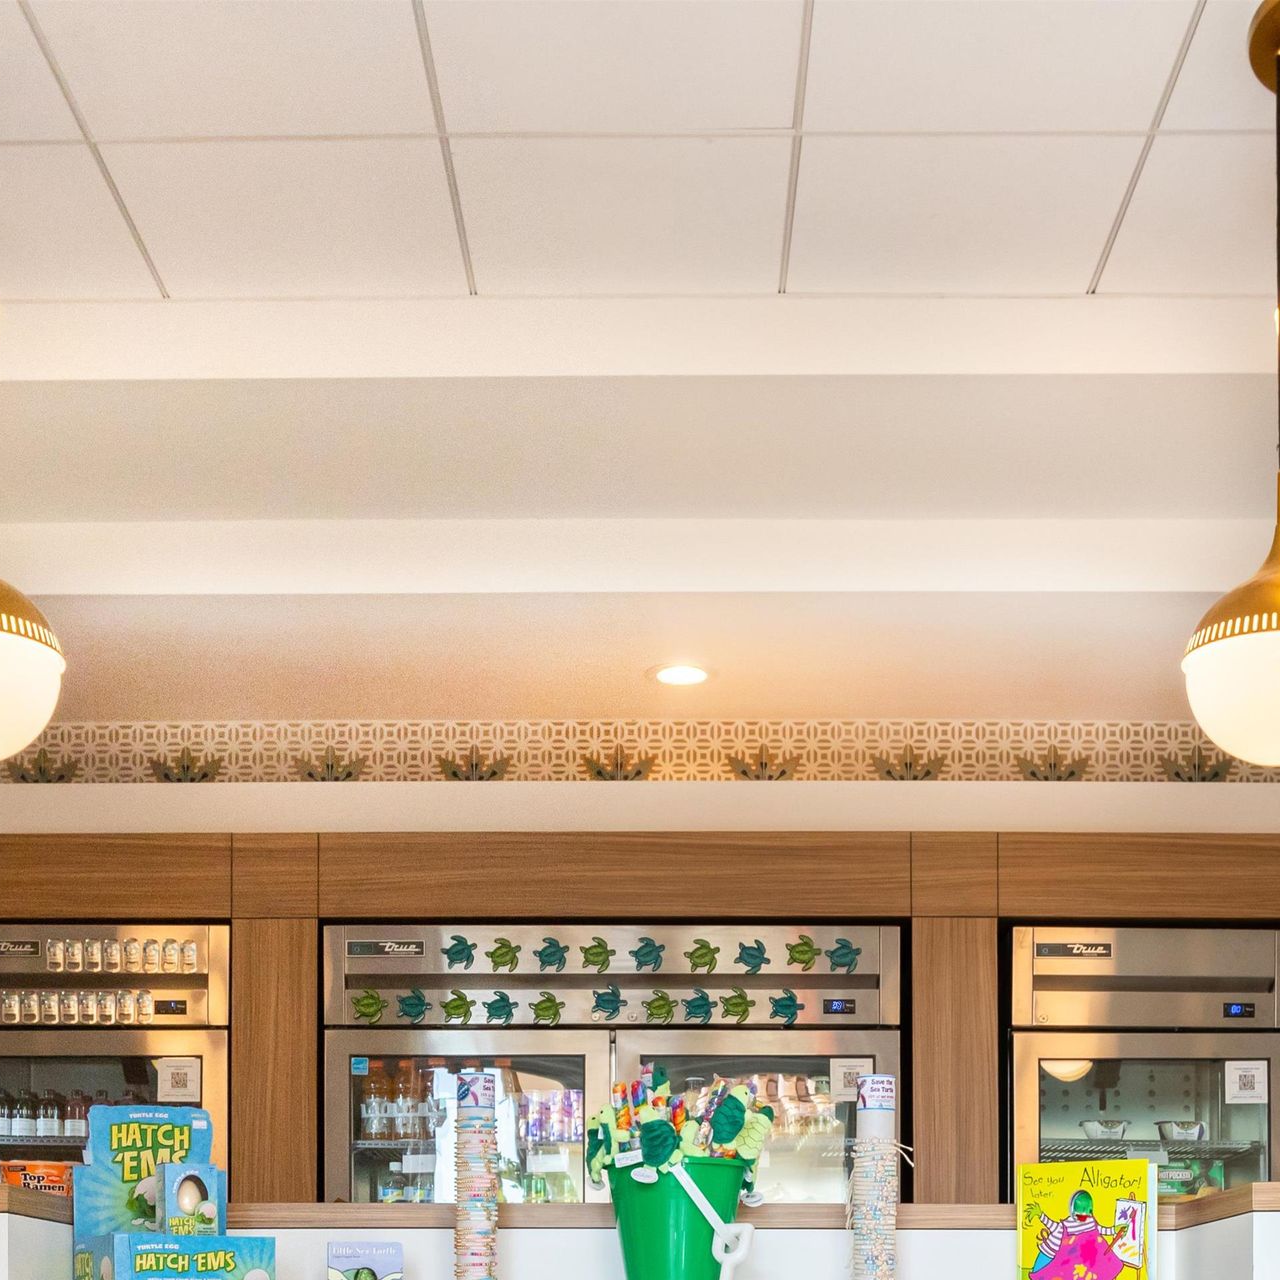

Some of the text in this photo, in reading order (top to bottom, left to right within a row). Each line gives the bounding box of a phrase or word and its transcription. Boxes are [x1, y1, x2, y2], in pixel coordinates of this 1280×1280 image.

[379, 942, 421, 952] True
[1067, 944, 1108, 954] True
[111, 1123, 190, 1151] HATCH
[21, 1173, 45, 1183] Top
[1023, 1172, 1064, 1185] See you
[1080, 1166, 1141, 1188] Alligator!
[23, 1182, 65, 1191] Ramen
[169, 1216, 195, 1226] HATCH
[332, 1247, 353, 1255] Little
[135, 1251, 236, 1272] HATCH 'EMS
